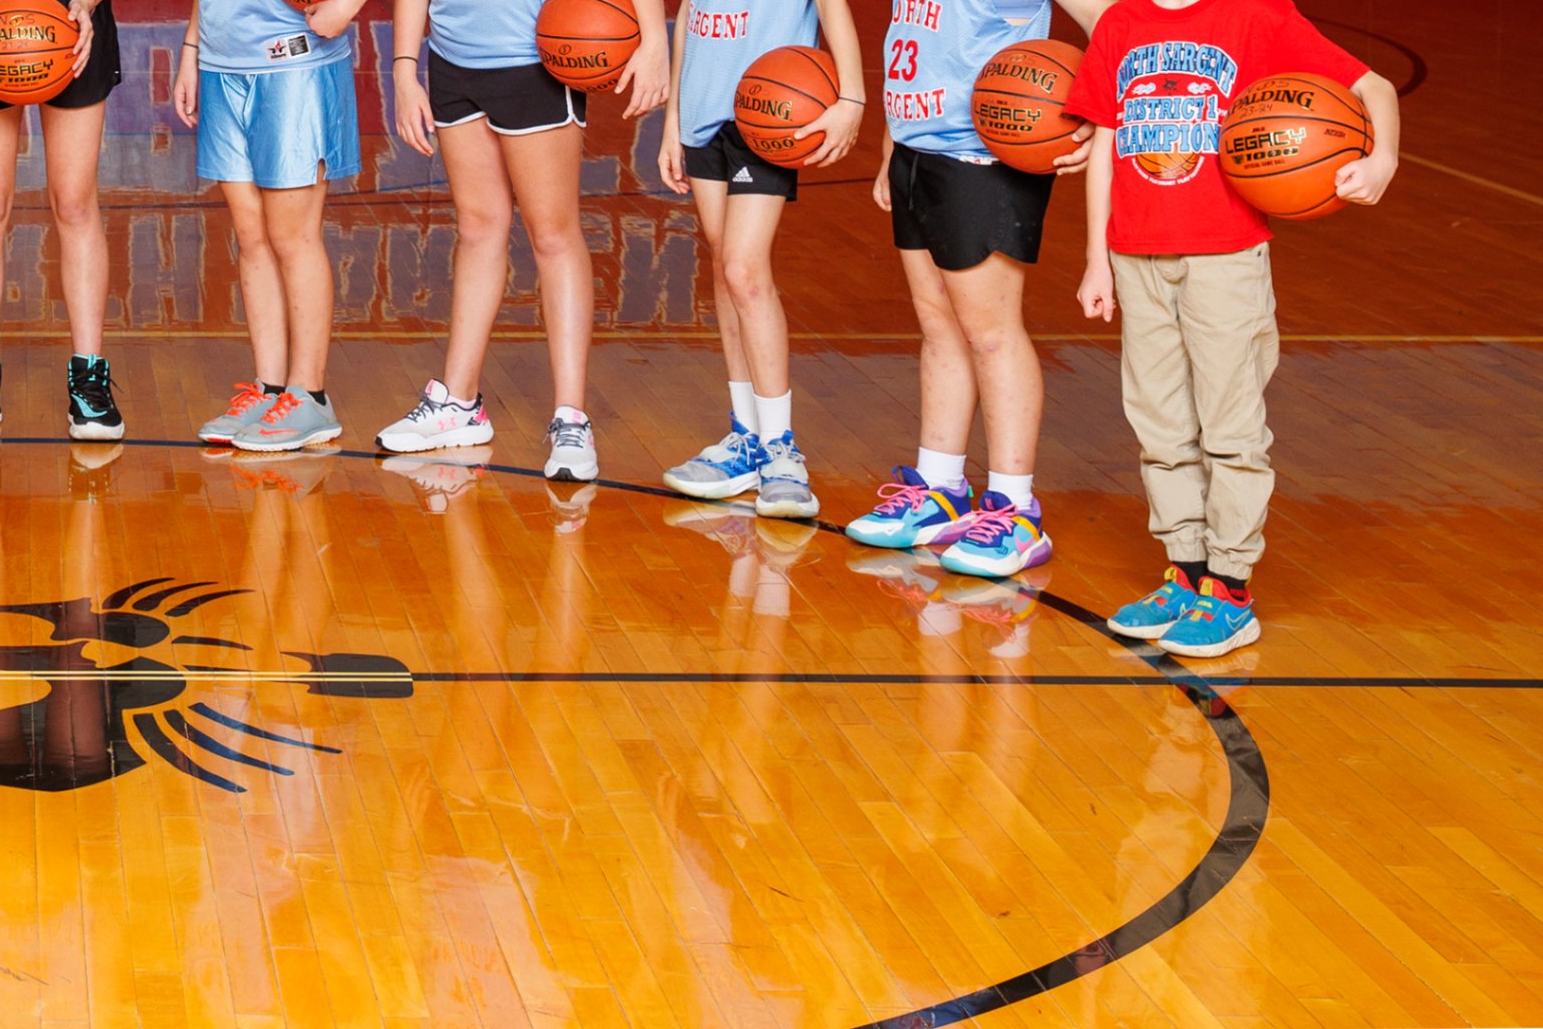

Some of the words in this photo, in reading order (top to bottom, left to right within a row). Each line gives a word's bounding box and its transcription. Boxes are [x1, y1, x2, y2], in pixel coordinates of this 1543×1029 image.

[888, 38, 918, 82] 23
[1117, 42, 1161, 103] NORTH
[1161, 41, 1238, 98] SARGENT
[1123, 96, 1205, 124] DISTRICT
[1206, 94, 1218, 122] 1
[1225, 126, 1306, 154] LEGACY
